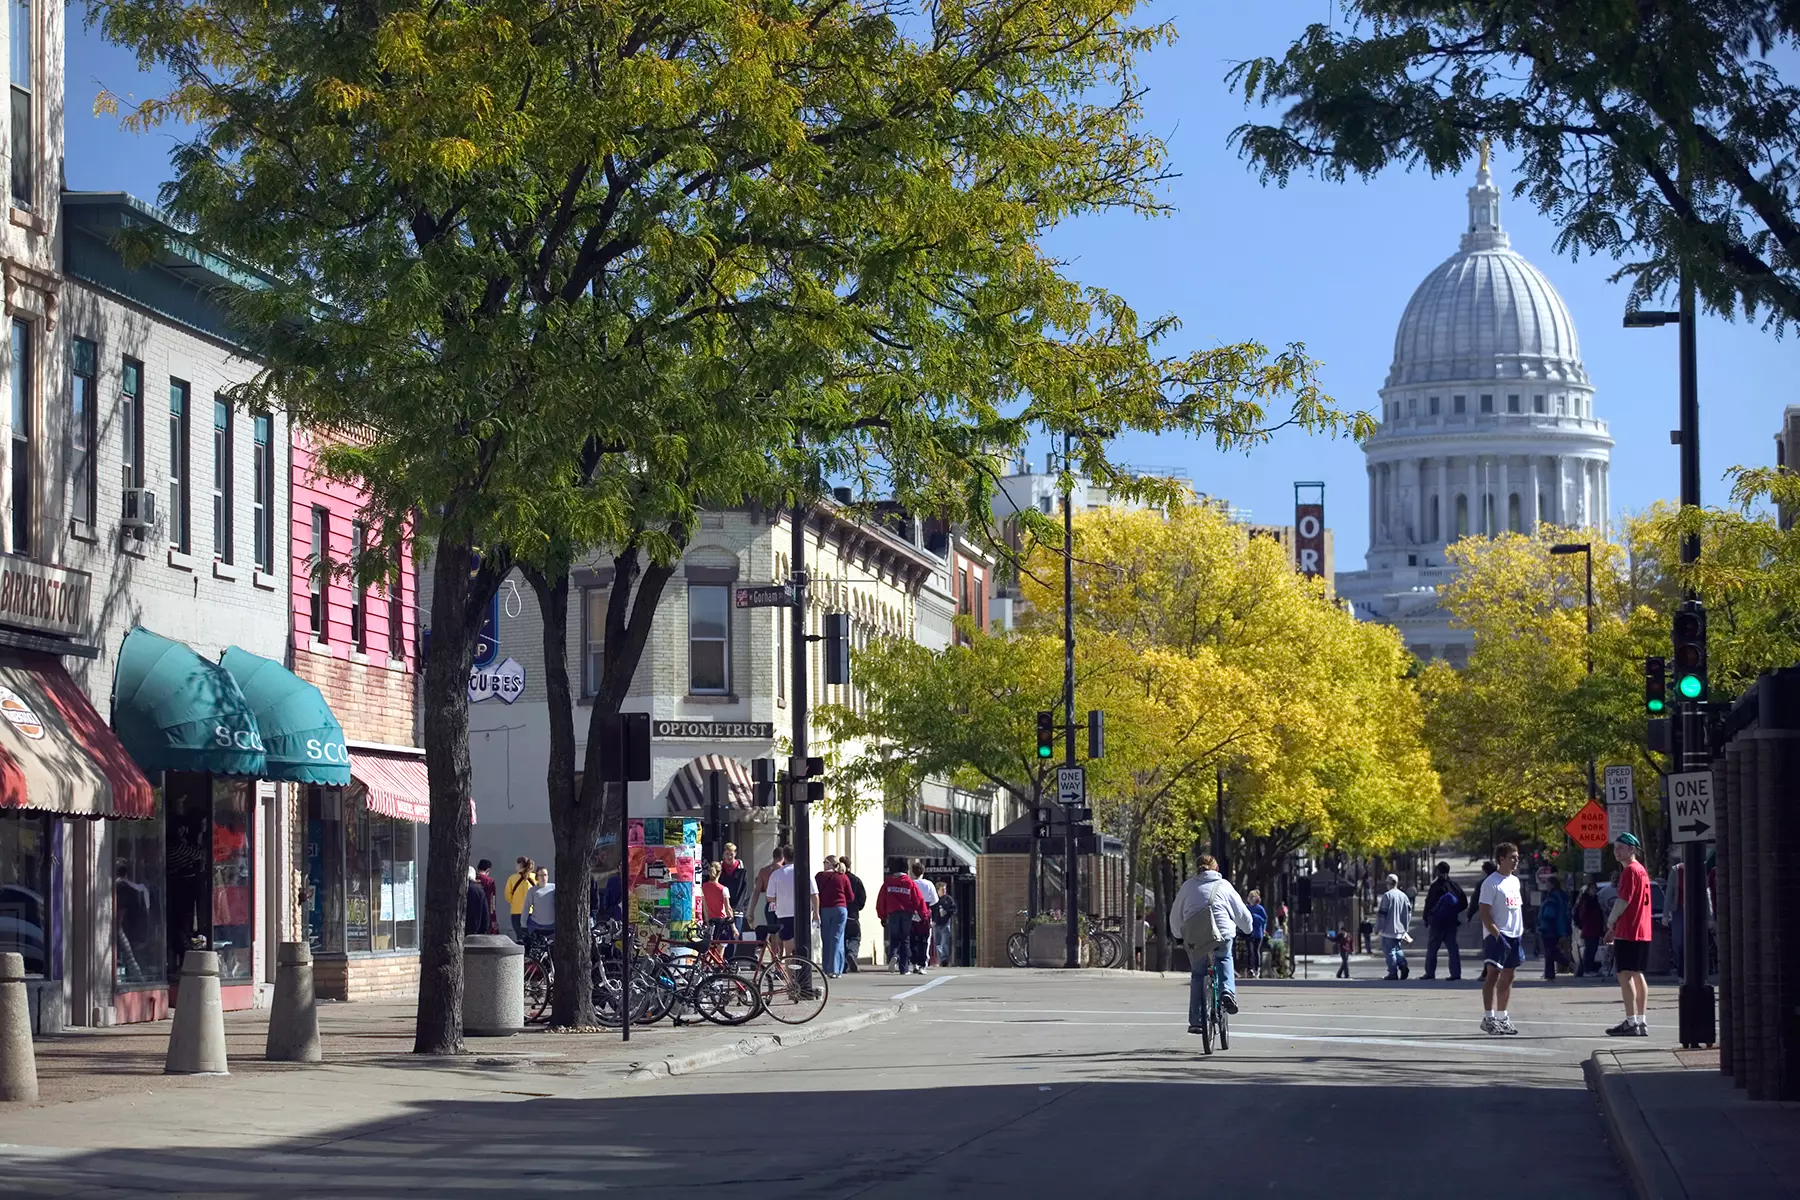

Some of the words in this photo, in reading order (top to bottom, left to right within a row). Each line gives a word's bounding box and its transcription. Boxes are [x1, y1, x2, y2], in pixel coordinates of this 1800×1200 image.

[1, 569, 84, 625] BIRKENSTOCK
[753, 590, 778, 603] Gorham
[659, 722, 767, 736] OPTOMETRIST
[1060, 772, 1080, 781] ONE
[1606, 768, 1630, 776] SPEED
[1609, 777, 1628, 785] LIMIT
[1060, 782, 1081, 790] WAY
[1675, 780, 1709, 797] ONE
[1611, 786, 1628, 800] 15
[1676, 798, 1710, 816] WAY
[1581, 813, 1604, 821] ROAD
[1581, 823, 1604, 831] WORK
[1579, 833, 1606, 841] AHEAD
